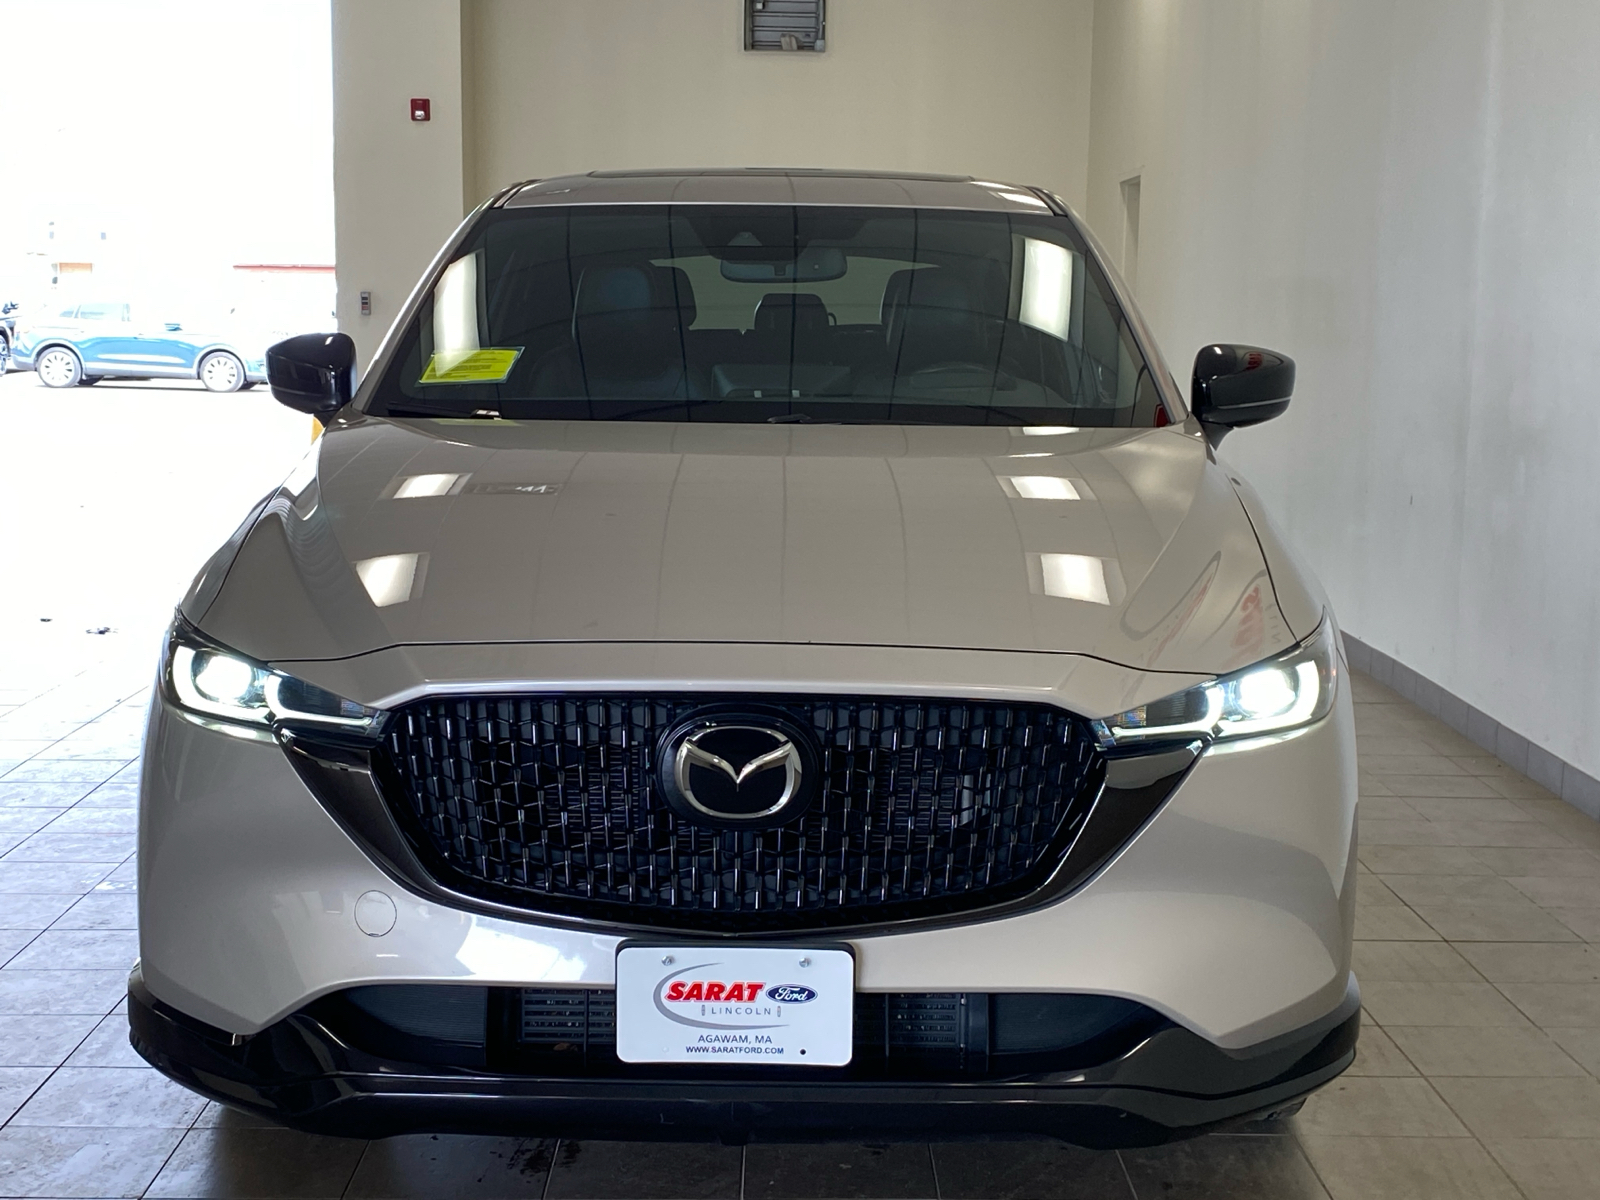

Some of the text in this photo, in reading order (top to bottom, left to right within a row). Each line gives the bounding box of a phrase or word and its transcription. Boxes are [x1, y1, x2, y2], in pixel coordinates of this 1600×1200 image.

[665, 981, 766, 1003] SARAT
[774, 987, 807, 1002] Ford
[711, 1007, 771, 1015] LINCOLN
[697, 1034, 772, 1045] AGAWAM, MA
[685, 1045, 784, 1055] WWW.SARATFORD.COM
